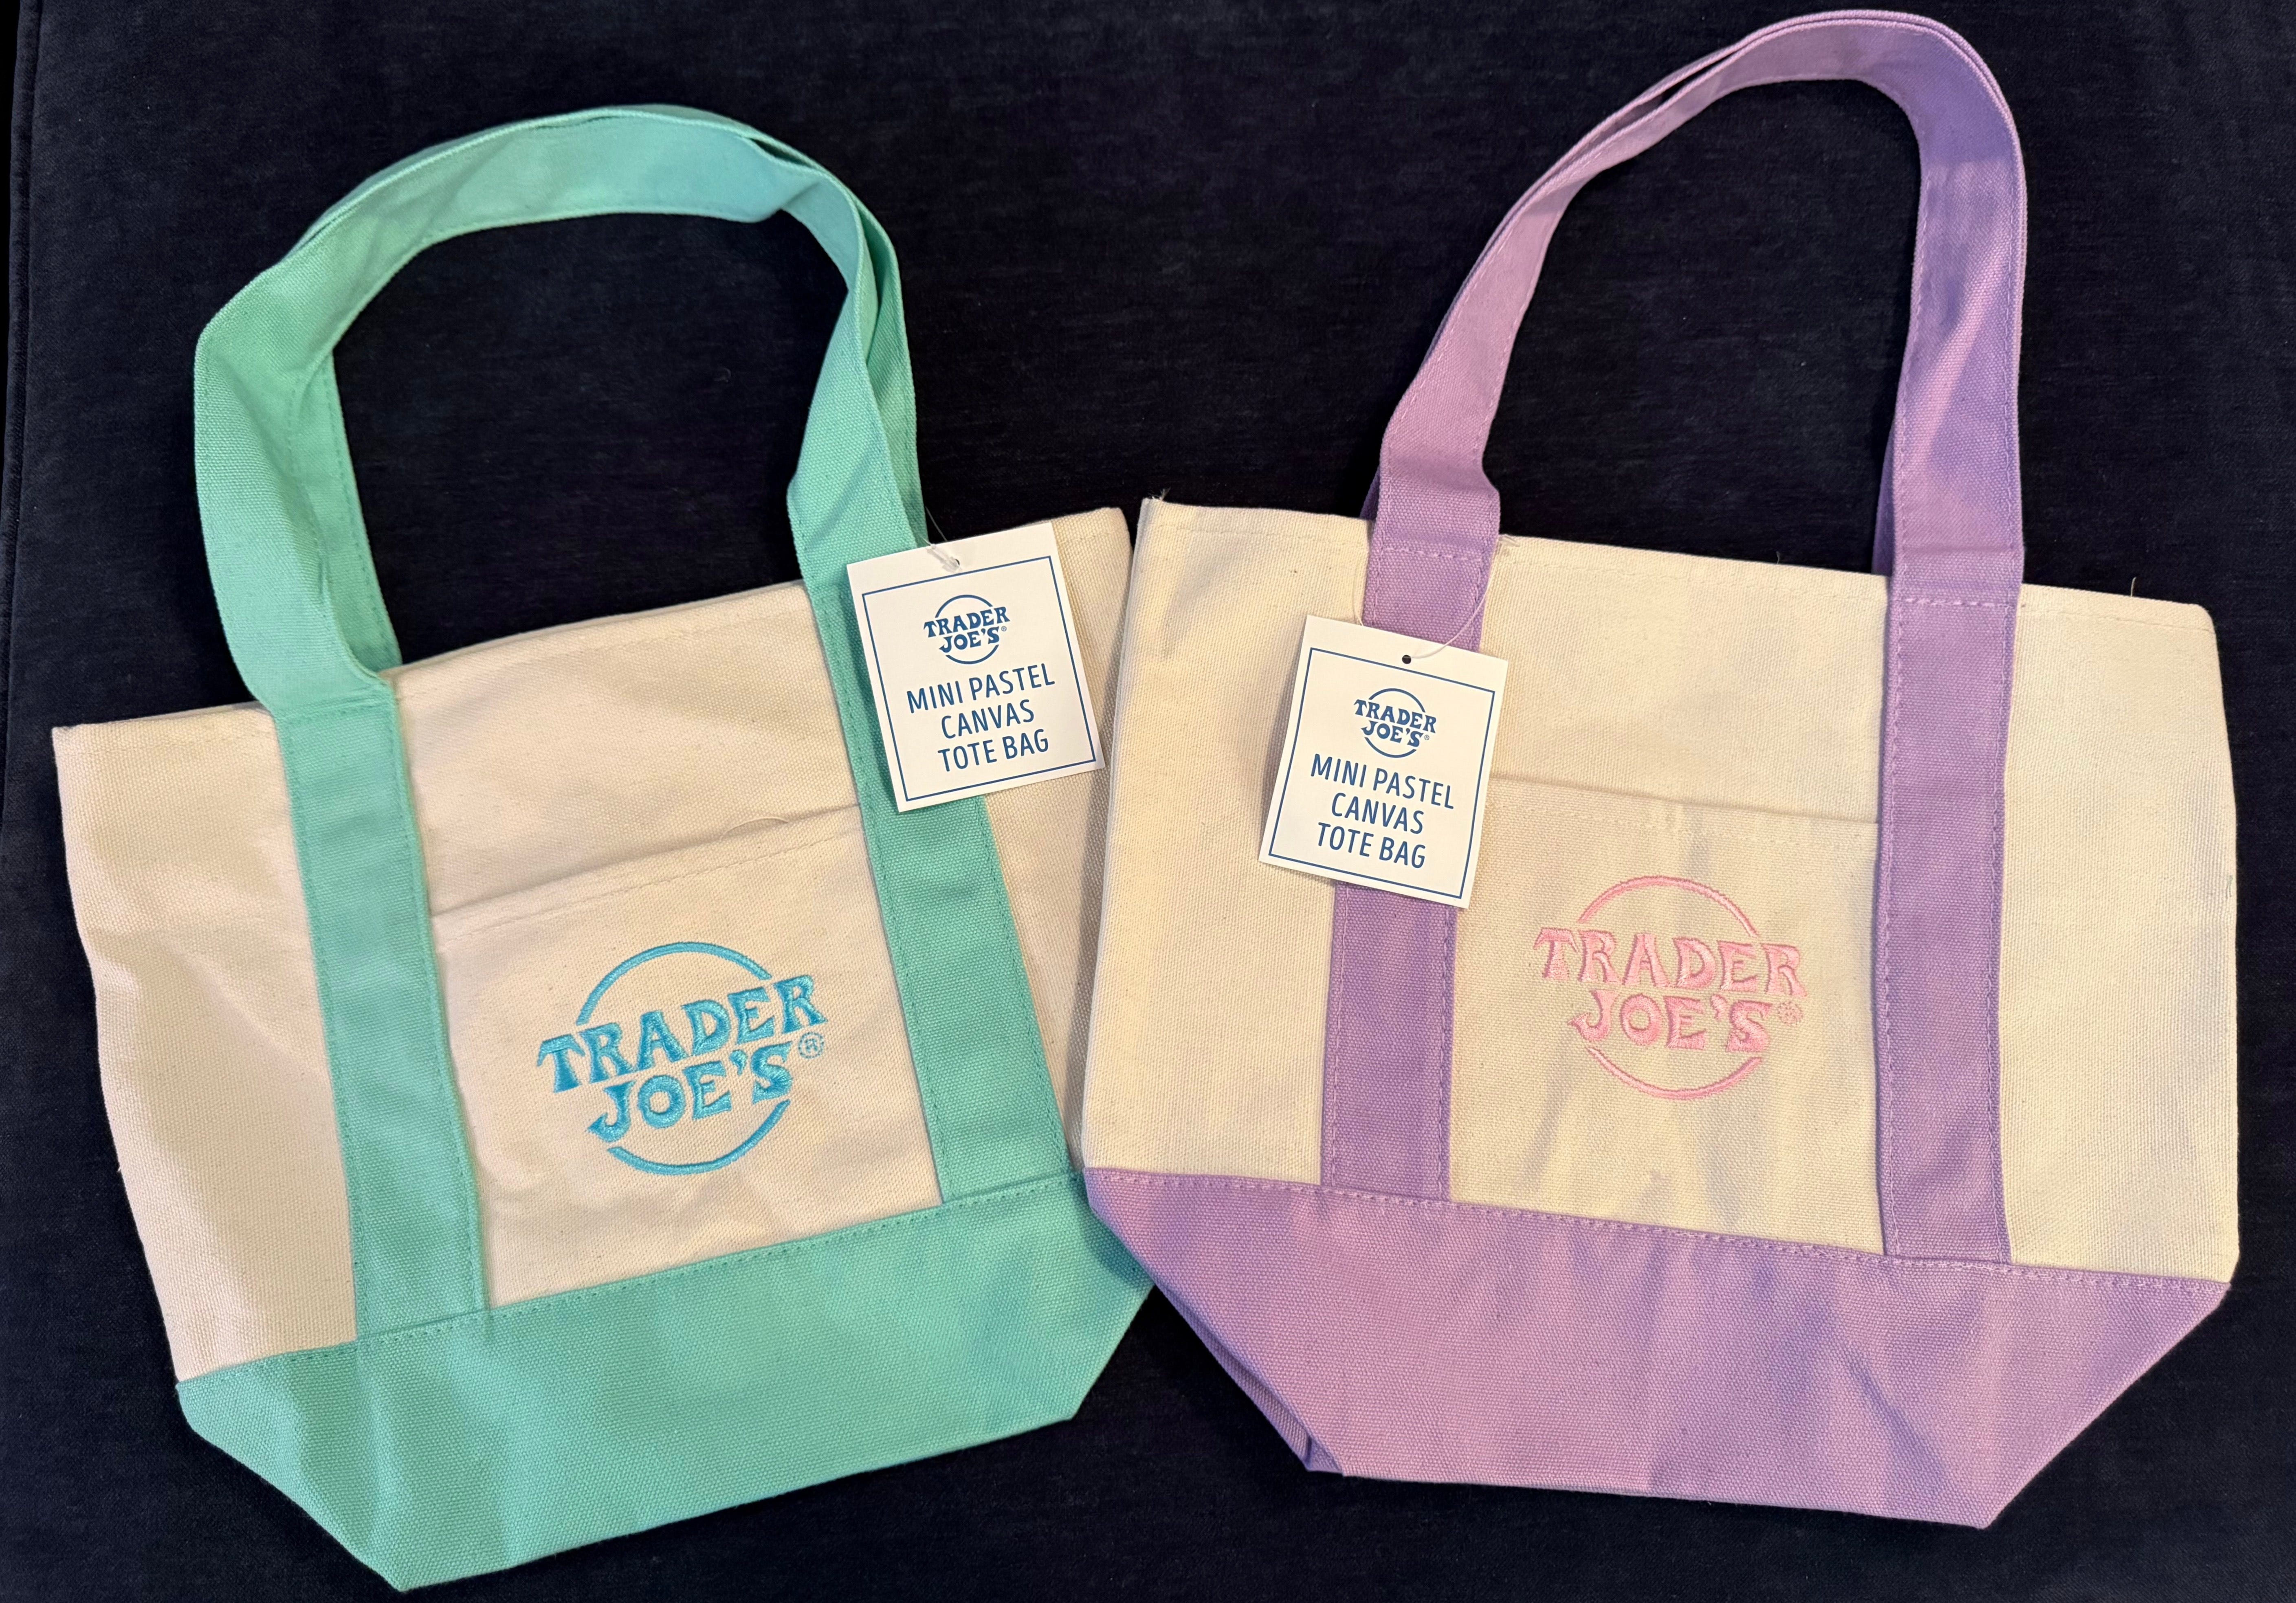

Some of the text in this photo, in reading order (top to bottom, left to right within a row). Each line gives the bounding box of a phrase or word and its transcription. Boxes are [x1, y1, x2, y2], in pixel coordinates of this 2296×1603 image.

[923, 606, 1010, 637] TRADER
[907, 663, 1055, 714] MINI PASTEL
[941, 699, 1034, 739] CANVAS
[1353, 699, 1436, 733] TRADER
[937, 729, 1049, 771] TOTE BAG
[1311, 754, 1454, 809] MINI PASTEL
[1332, 793, 1424, 834] CANVAS
[1318, 822, 1425, 869] TOTE BAG
[1533, 927, 1807, 997] TRADER
[537, 974, 829, 1094] TRADER
